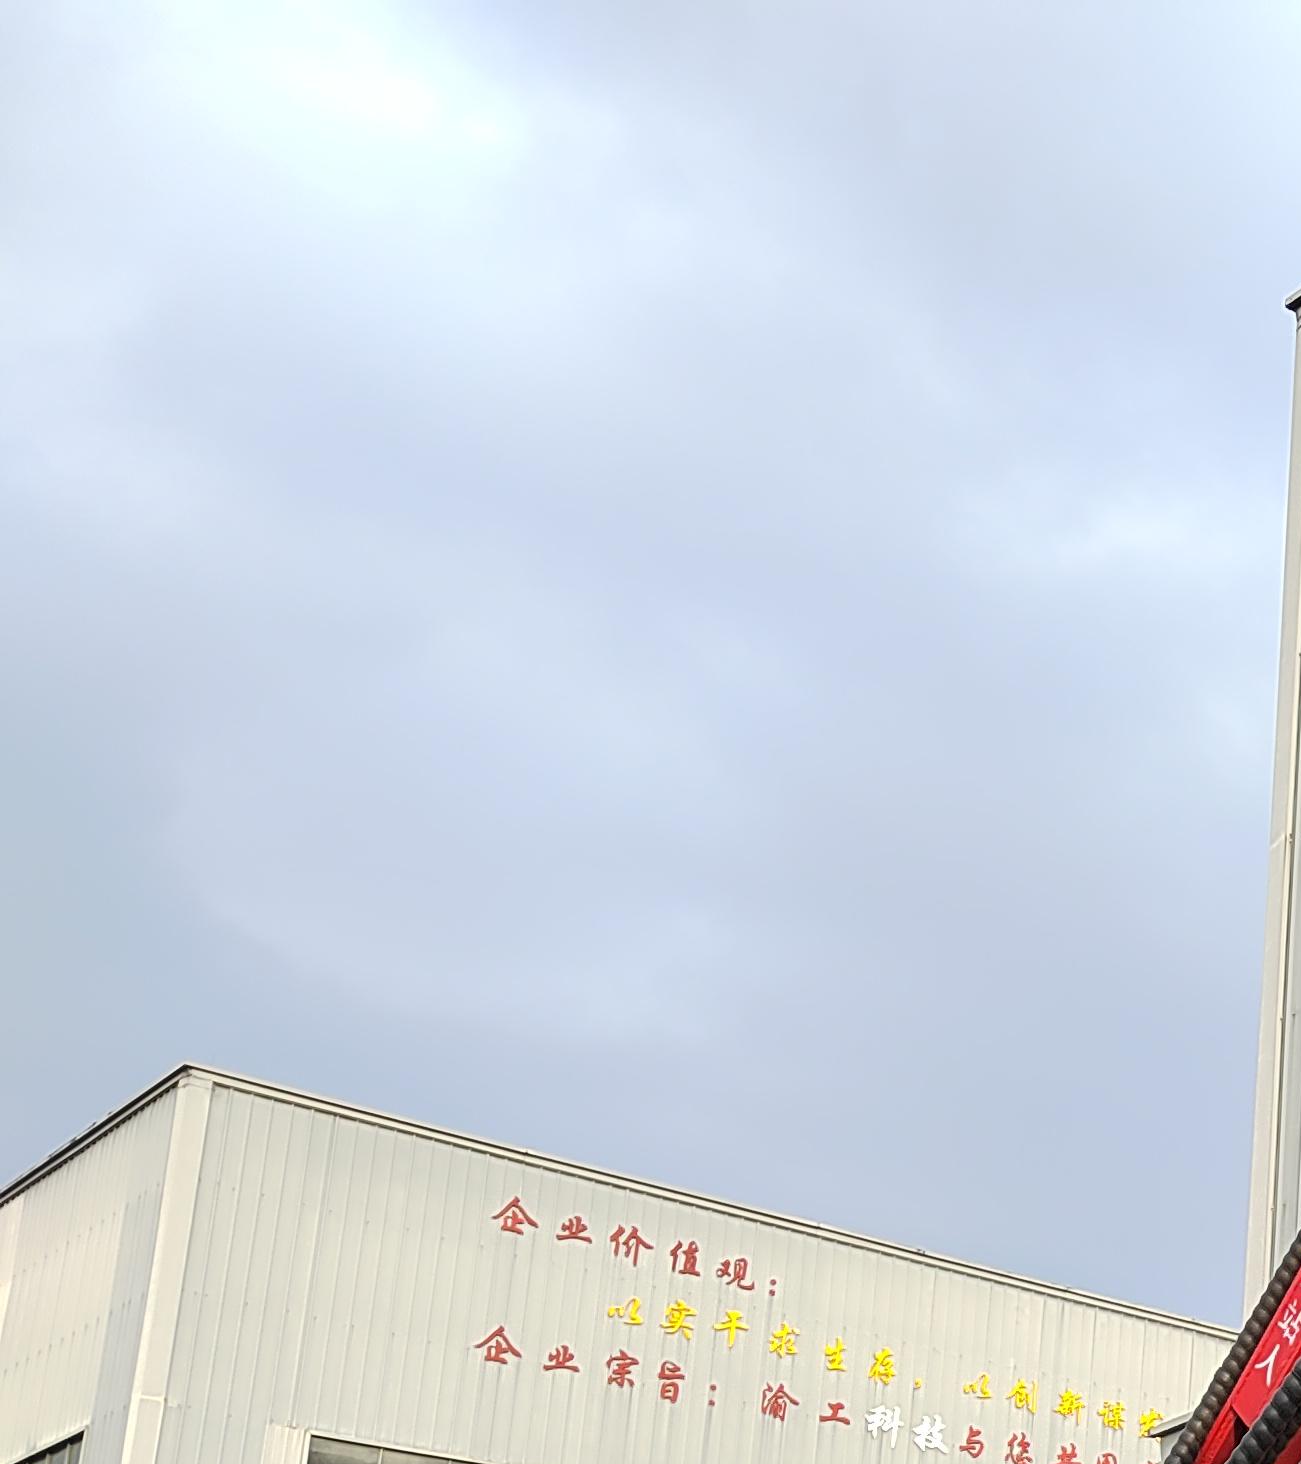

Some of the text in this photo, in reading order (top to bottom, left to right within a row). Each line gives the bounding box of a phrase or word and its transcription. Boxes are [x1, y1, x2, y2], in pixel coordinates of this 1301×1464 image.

[490, 1196, 778, 1298] 企业价值观：
